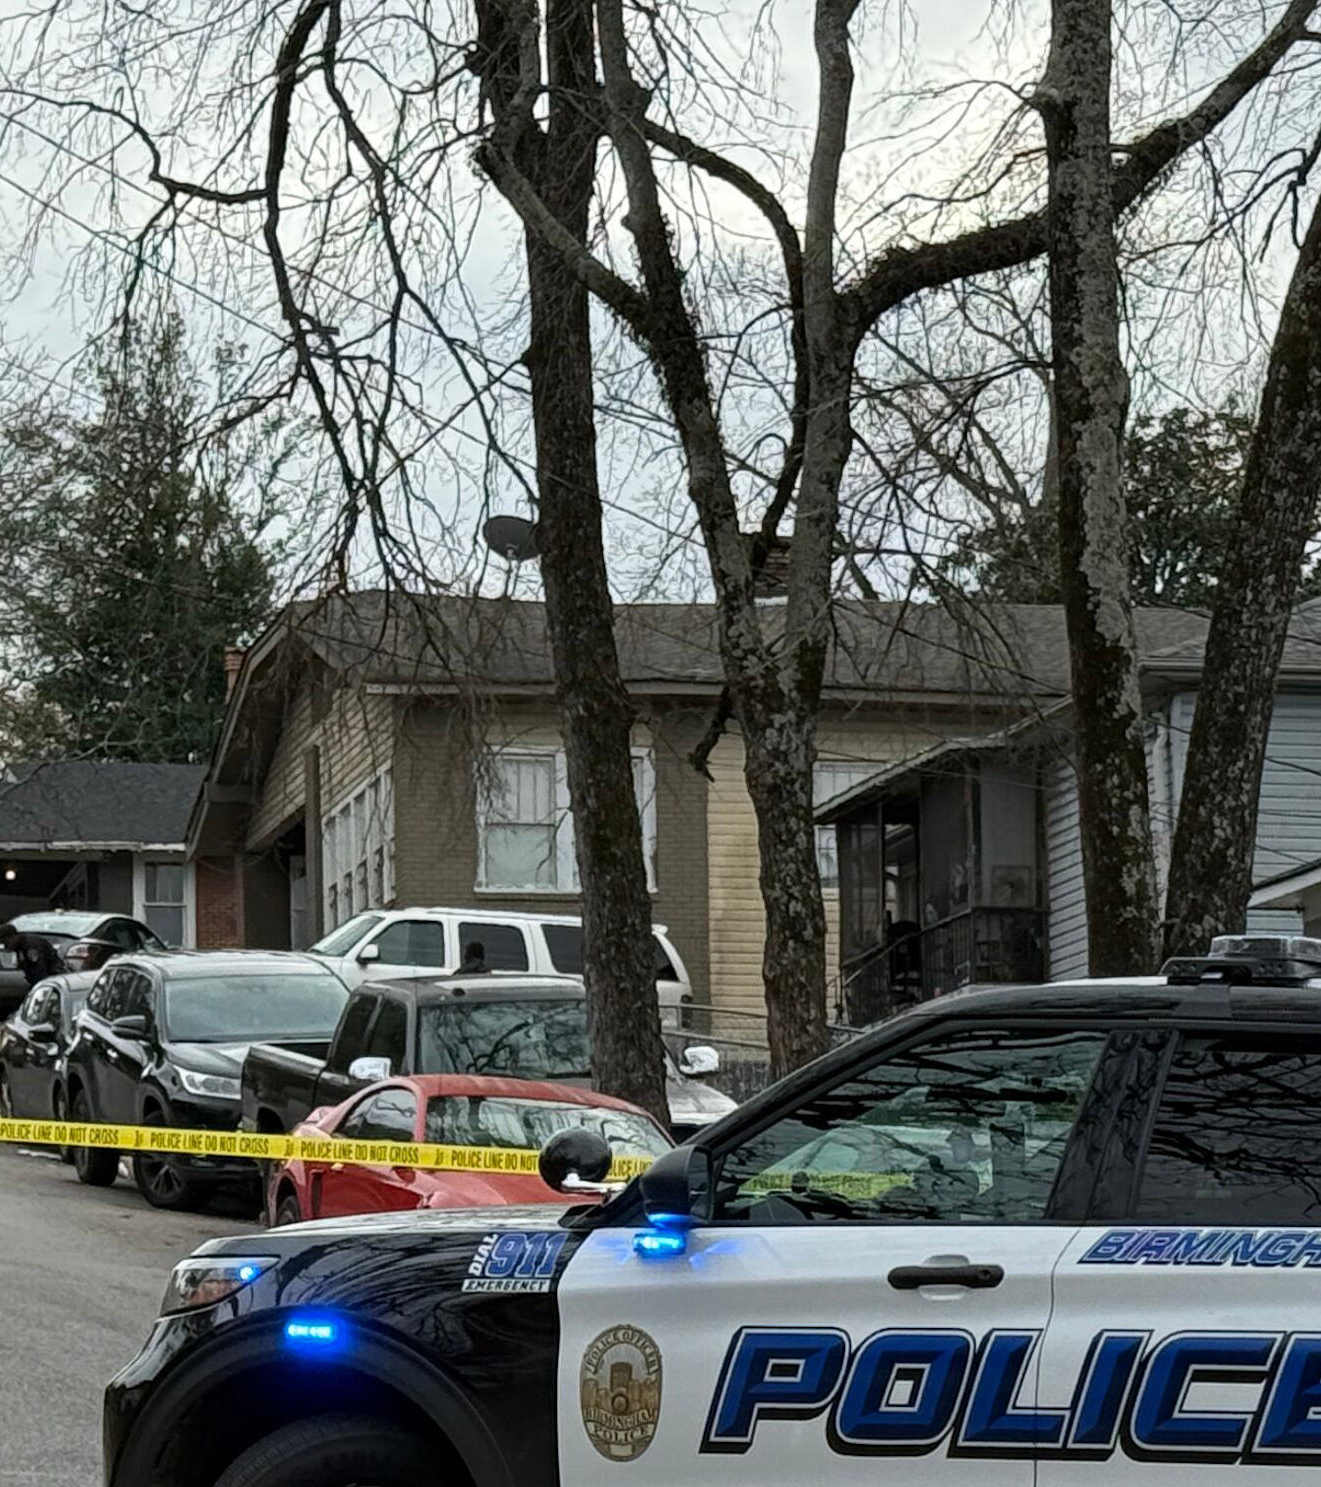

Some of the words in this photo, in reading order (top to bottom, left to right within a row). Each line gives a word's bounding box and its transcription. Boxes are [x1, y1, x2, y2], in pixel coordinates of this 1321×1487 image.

[0, 1122, 30, 1138] POLICE
[32, 1124, 52, 1141] LINE
[54, 1126, 67, 1142] DO
[69, 1127, 87, 1143] NOT
[89, 1128, 118, 1145] CROSS
[150, 1132, 181, 1148] POLICE
[183, 1134, 203, 1150] LINE
[205, 1135, 218, 1151] DO
[220, 1136, 237, 1152] NOT
[239, 1137, 270, 1155] CROSS
[301, 1141, 331, 1158] POLICE
[333, 1142, 353, 1160] LINE
[355, 1144, 367, 1160] DO
[370, 1145, 387, 1161] NOT
[389, 1146, 419, 1163] CROSS
[451, 1150, 481, 1167] POLICE
[483, 1152, 504, 1168] LINE
[505, 1153, 518, 1169] DO
[520, 1154, 539, 1171] NOT
[468, 1234, 499, 1276] DIAL
[484, 1232, 570, 1278] 911
[464, 1280, 547, 1292] EMERGENCY
[585, 1329, 620, 1372] POLICE
[622, 1330, 660, 1373] OFFICER
[583, 1407, 658, 1429] BIRMINGHAM
[592, 1423, 650, 1442] POLICE
